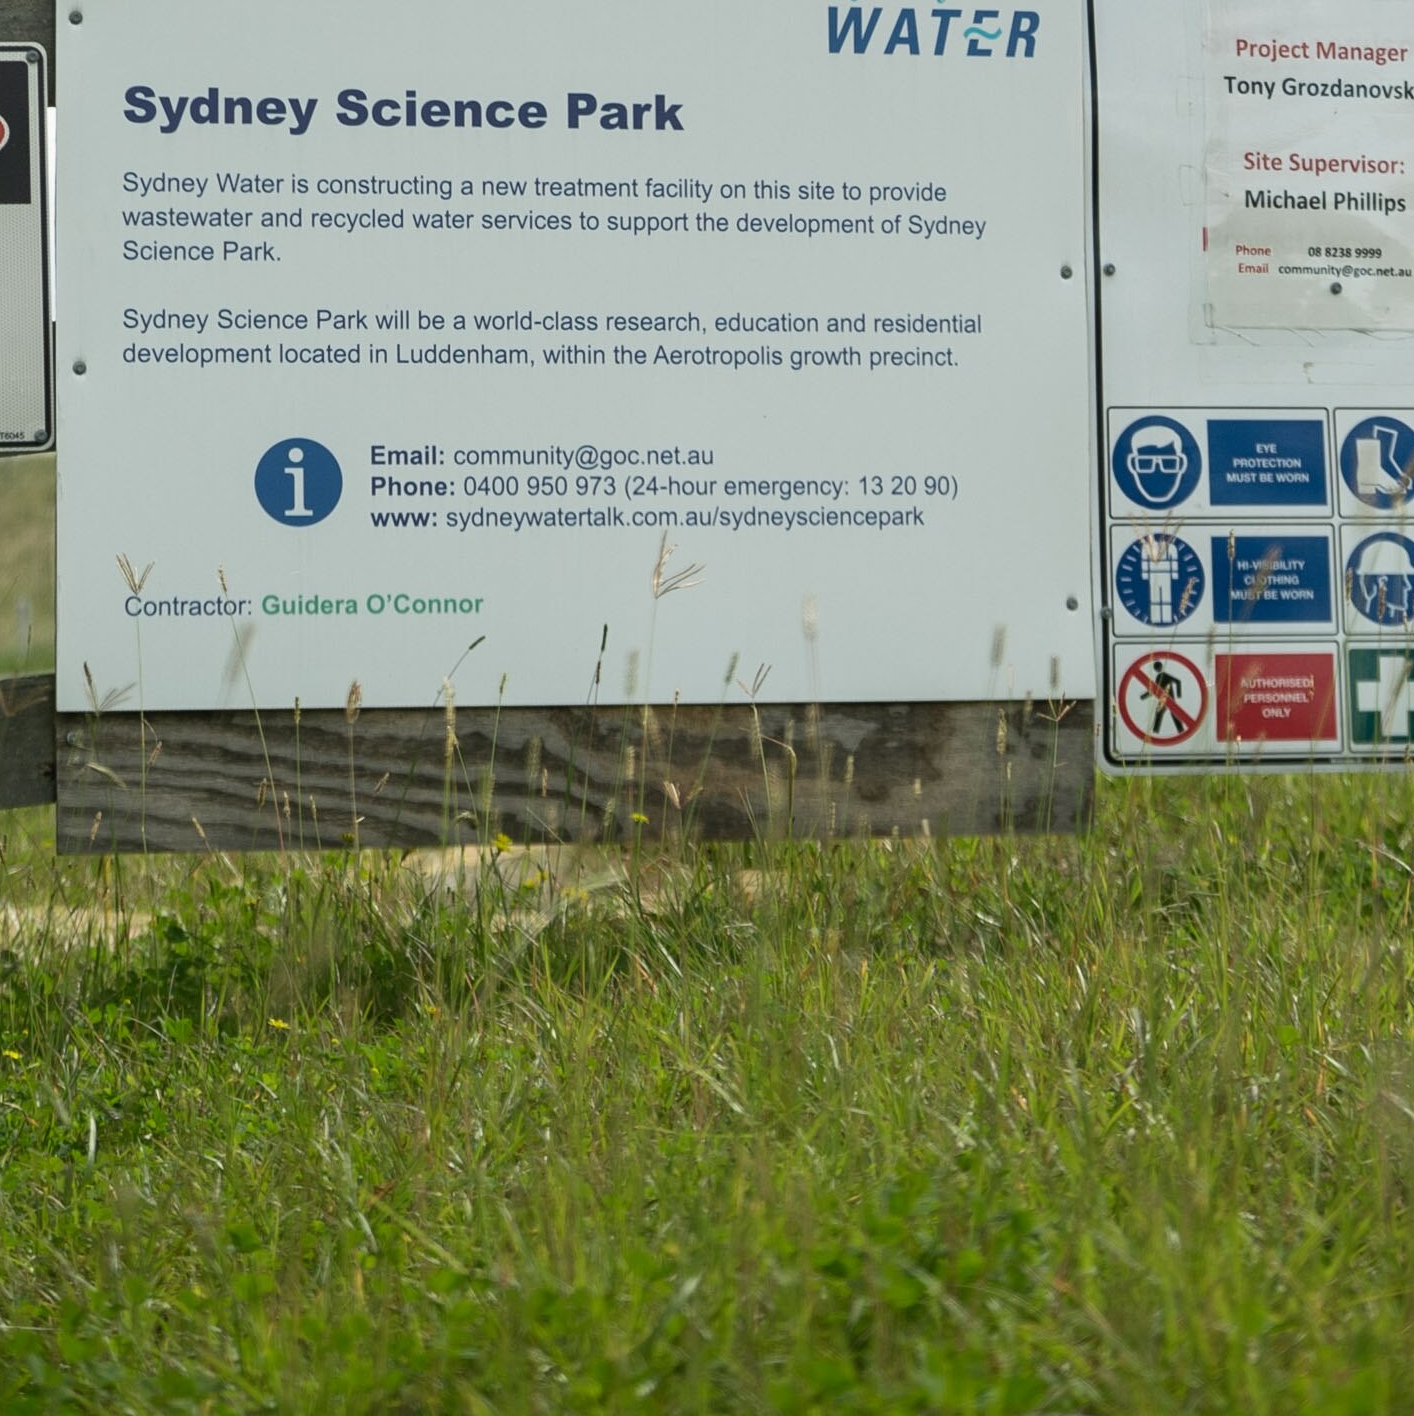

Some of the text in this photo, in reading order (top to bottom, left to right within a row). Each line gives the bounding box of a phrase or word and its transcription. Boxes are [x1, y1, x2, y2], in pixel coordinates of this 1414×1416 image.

[828, 6, 1040, 57] WATER
[1235, 38, 1409, 66] Project Manager
[1223, 75, 1276, 100] Tony
[123, 85, 685, 136] Sydney Science Park
[1243, 151, 1405, 177] Site Supervisor:
[122, 171, 947, 206] Sydney Water is constructing a new treatment facility on this site to provide
[1244, 189, 1407, 217] Michael Phillips
[121, 207, 987, 241] wastewater and recycled water services to support the development of Sydney
[122, 239, 281, 262] Science Park.
[1235, 244, 1383, 260] Phone 08 8238 9999
[1237, 262, 1413, 279] Email community@goc.net.au
[122, 308, 982, 335] Sydney Science Park will be a world-class research, education and residential
[122, 342, 959, 371] development located in Luddenham, within the Aerotropolis growth precinct.
[370, 444, 714, 471] Email: community@goc.net.au
[1256, 444, 1277, 453] EYE
[1233, 458, 1302, 468] PROTECTION
[371, 475, 959, 502] Phone: 0400 950 973 (24-hour emergency: 13 20 90)
[1226, 472, 1309, 484] MUST BE WORN
[370, 505, 925, 533] www: sydneywatertalk.com.au/sydneysciencepark
[124, 593, 484, 617] Contractor: Guidera O'Connor
[1231, 590, 1314, 600] MUST BE WORN
[1241, 678, 1310, 688] AUTHORISED
[1244, 693, 1309, 703] PERSONNEL
[1262, 707, 1291, 718] ONLY
